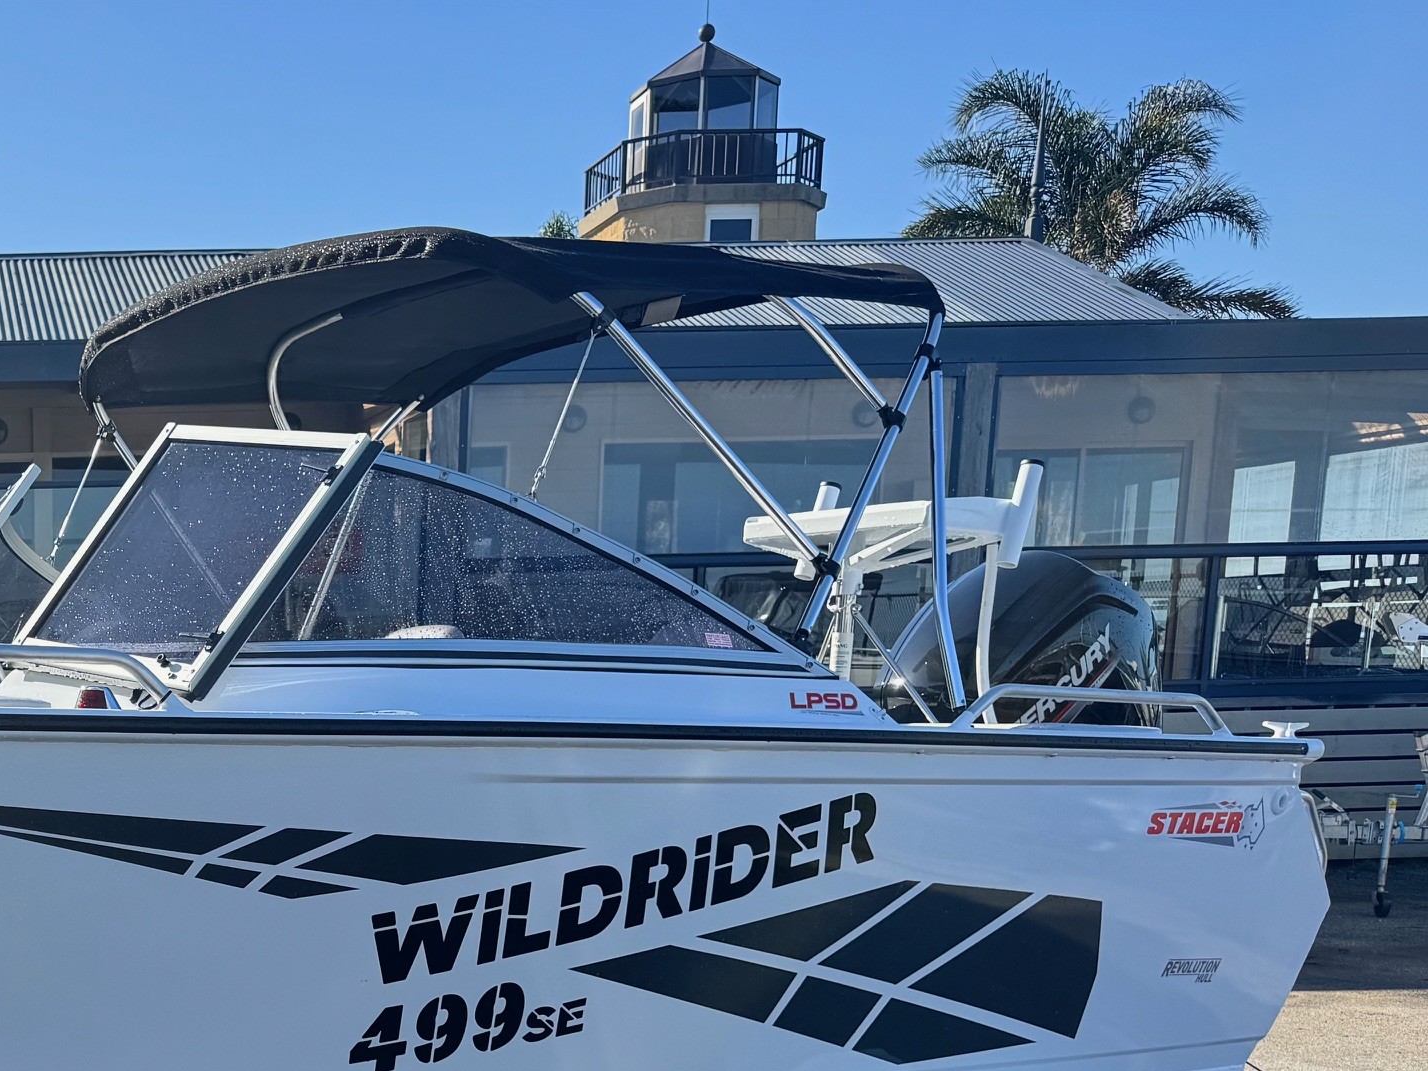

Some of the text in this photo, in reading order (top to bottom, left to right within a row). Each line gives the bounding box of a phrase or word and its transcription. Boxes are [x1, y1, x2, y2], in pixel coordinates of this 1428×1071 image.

[789, 692, 858, 710] LPSD
[1146, 811, 1244, 835] STACER
[1161, 960, 1221, 977] REVOLUTION
